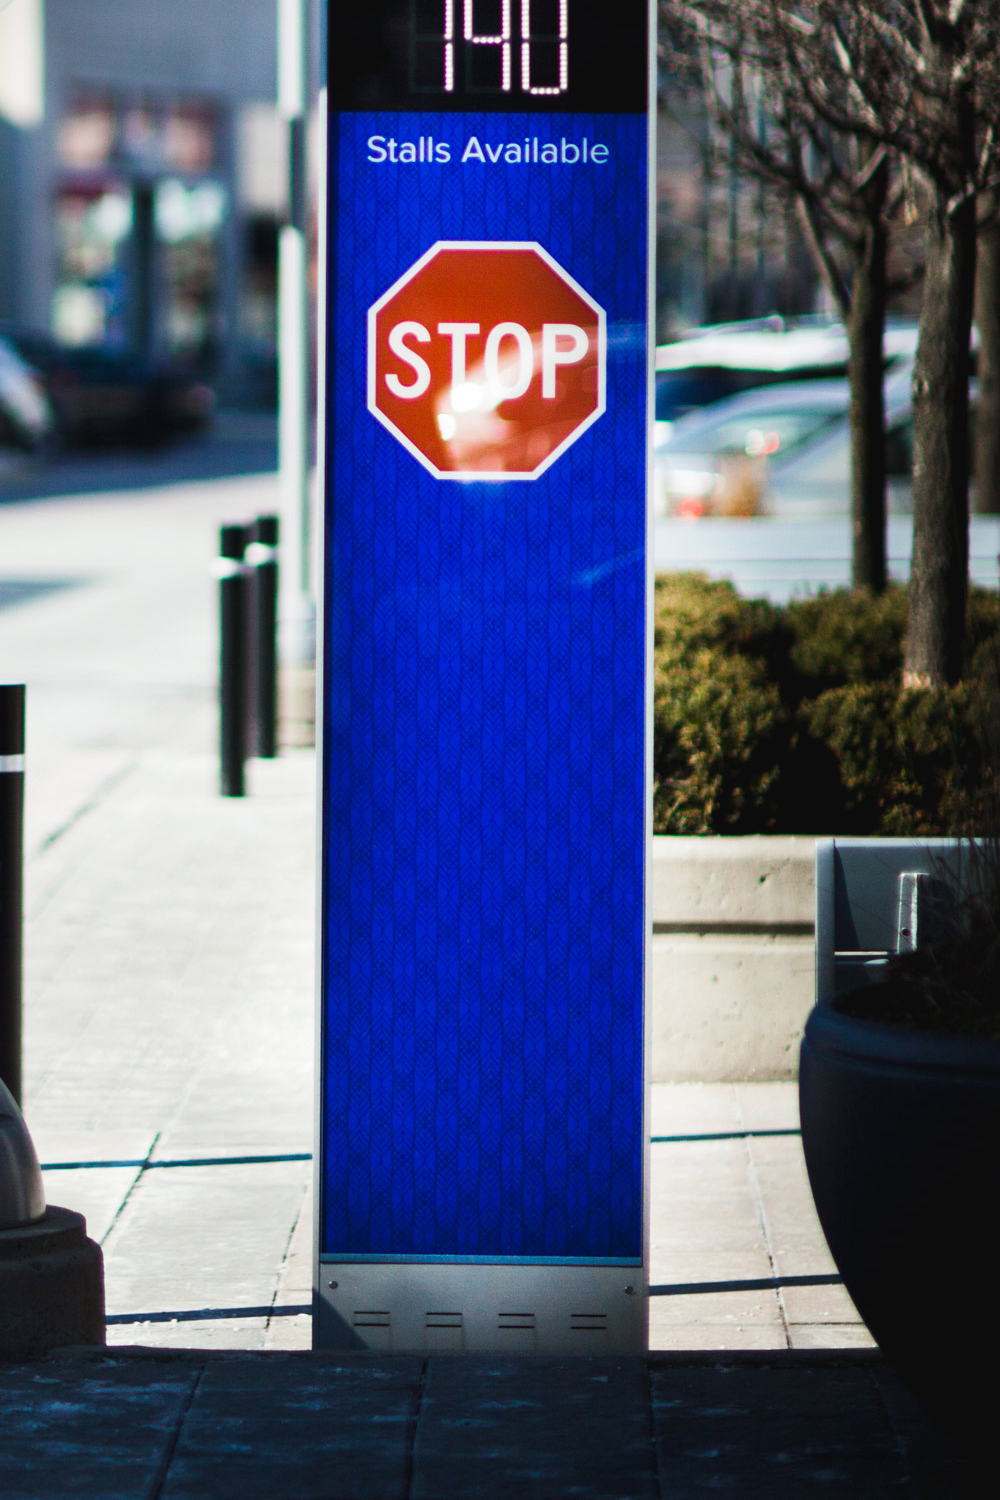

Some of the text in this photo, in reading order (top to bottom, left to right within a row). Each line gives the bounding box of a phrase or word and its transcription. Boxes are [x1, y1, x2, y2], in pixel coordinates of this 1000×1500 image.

[367, 135, 610, 165] Stalls Available
[385, 321, 589, 400] STOP
